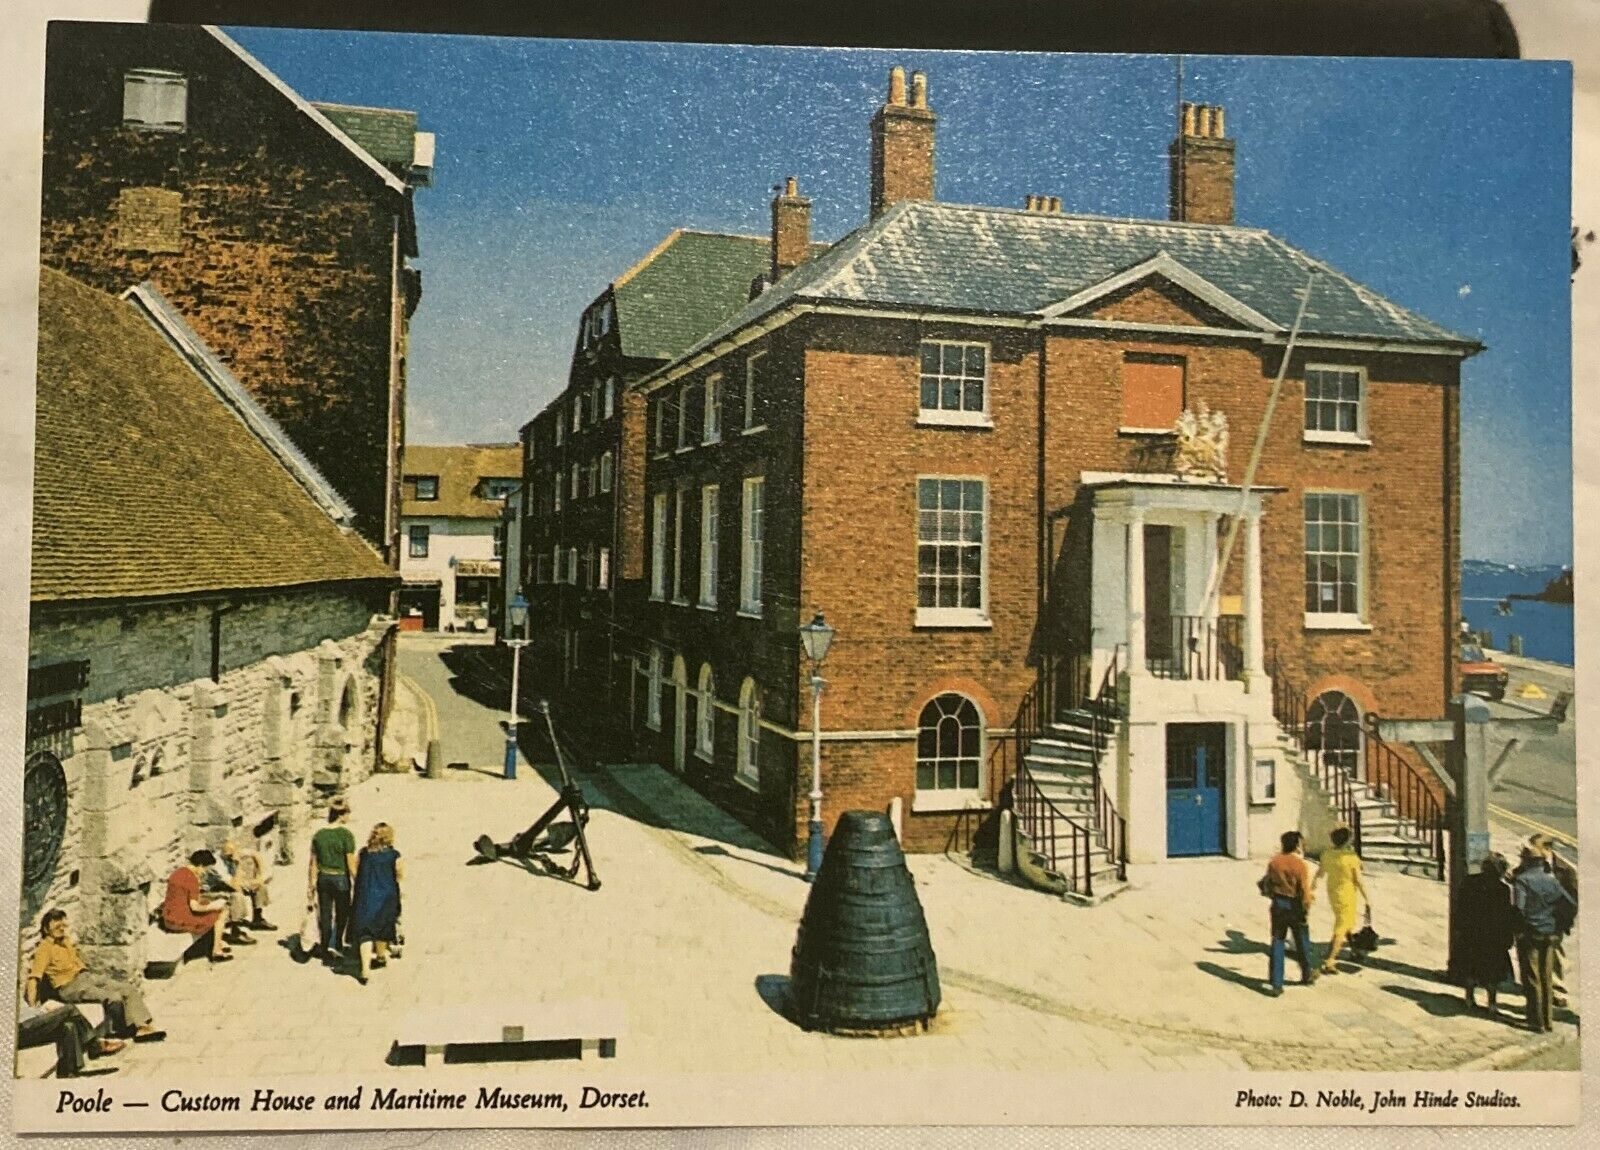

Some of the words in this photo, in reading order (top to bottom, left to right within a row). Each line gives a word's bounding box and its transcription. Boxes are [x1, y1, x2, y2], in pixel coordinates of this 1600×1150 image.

[56, 1088, 113, 1113] Poole
[161, 1089, 240, 1112] Custom
[251, 1089, 315, 1111] House
[325, 1086, 362, 1111] and
[371, 1087, 466, 1111] Maritime
[475, 1087, 567, 1112] Museum,
[579, 1086, 649, 1109] Dorset.
[1235, 1089, 1282, 1108] Photo:
[1289, 1090, 1307, 1108] D.
[1316, 1089, 1365, 1110] Noble,
[1369, 1089, 1407, 1113] John
[1413, 1089, 1459, 1108] Hinde
[1465, 1089, 1521, 1108] Studios.
